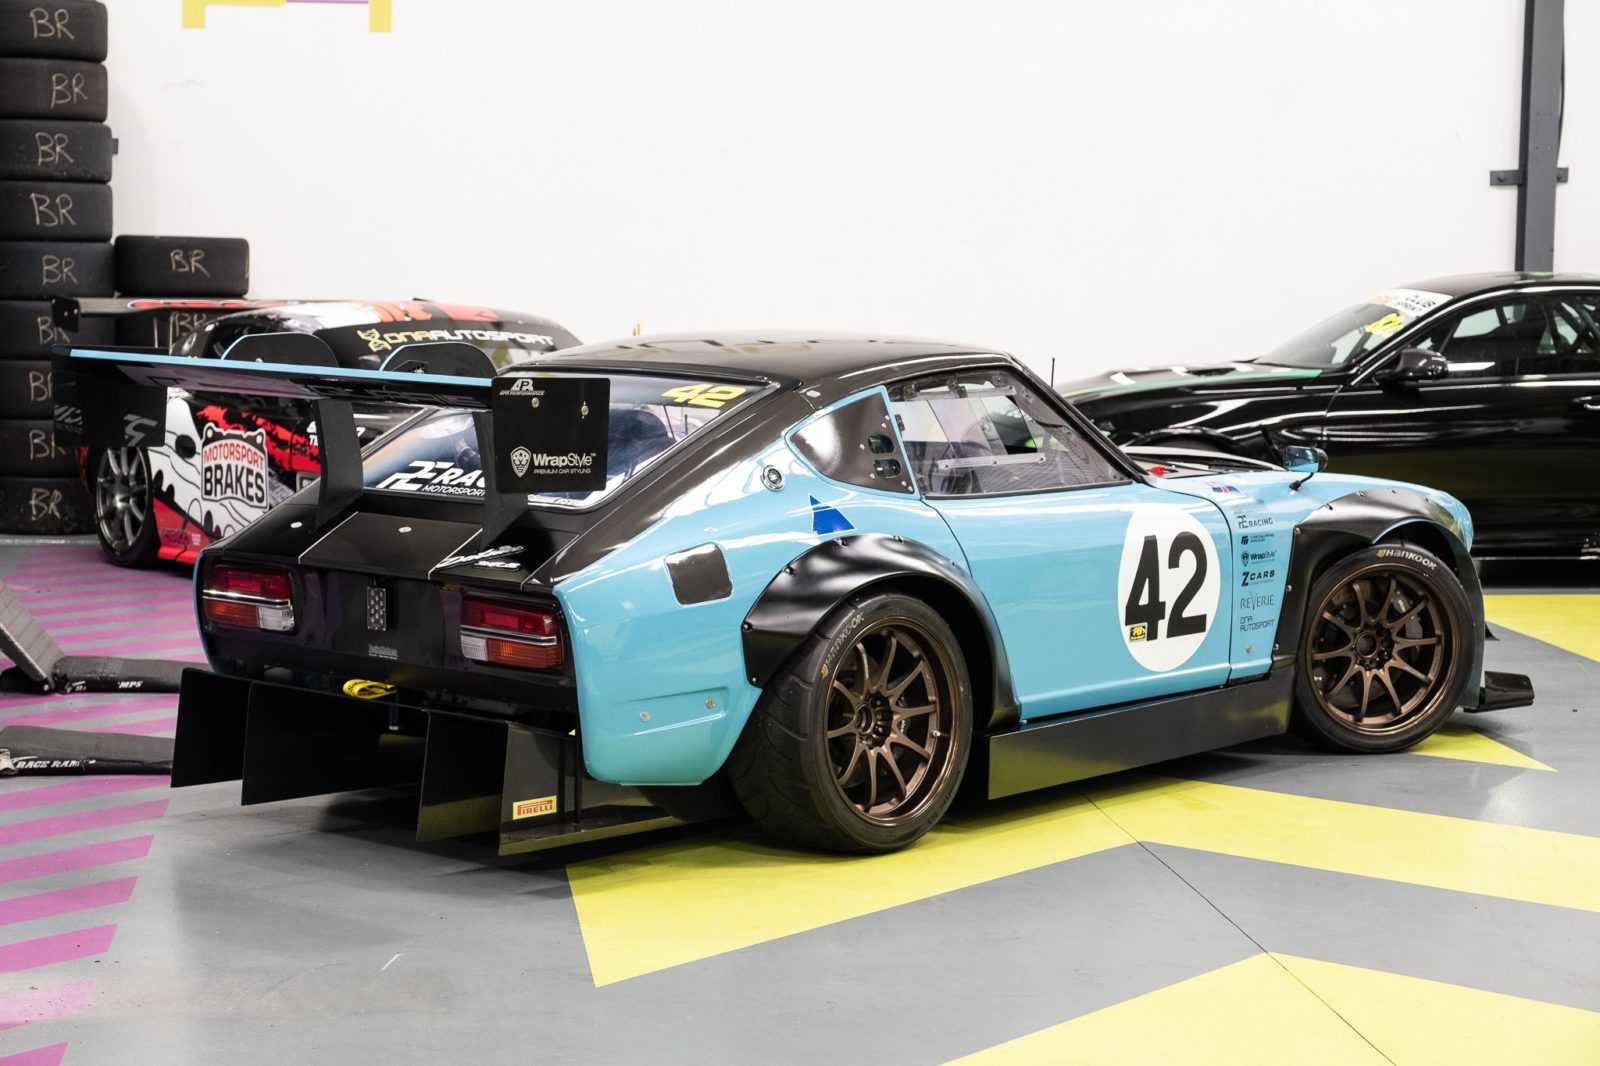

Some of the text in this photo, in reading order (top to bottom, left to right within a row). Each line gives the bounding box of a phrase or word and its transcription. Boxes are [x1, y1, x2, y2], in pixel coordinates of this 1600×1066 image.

[30, 8, 74, 40] BR
[51, 73, 88, 108] BR
[35, 132, 74, 165] BR
[30, 192, 76, 227] BR
[42, 255, 78, 285] BR
[170, 249, 211, 278] BR
[29, 371, 53, 401] B
[660, 383, 748, 409] 42
[204, 443, 264, 471] MOTORSPORT
[204, 463, 265, 504] BRAKES
[29, 488, 62, 521] BR
[1248, 517, 1274, 528] RACING
[1125, 530, 1208, 642] 42
[1240, 591, 1275, 611] REVERIE
[1240, 619, 1275, 632] AUTOSPORT
[517, 799, 553, 816] PIRELLI
